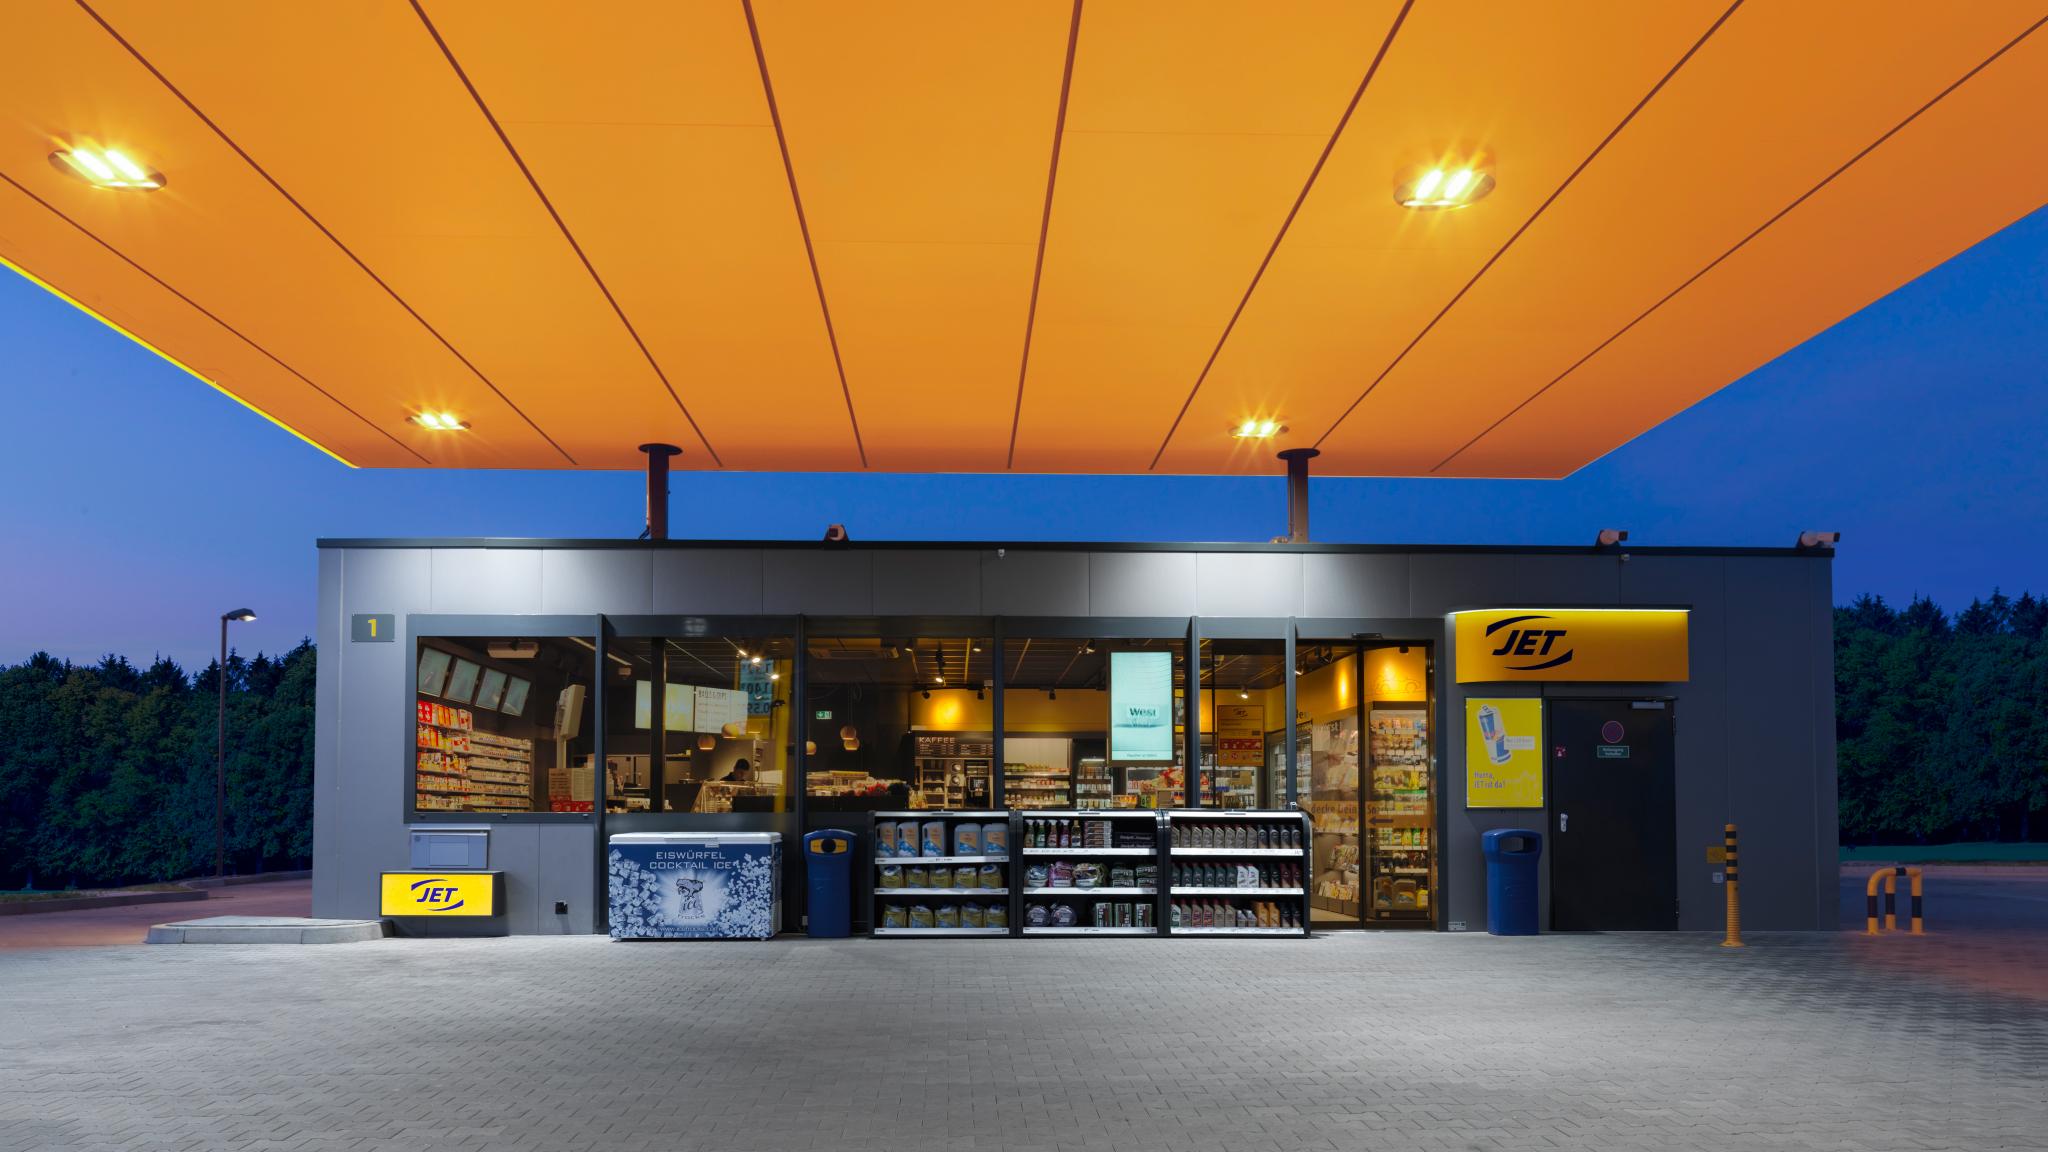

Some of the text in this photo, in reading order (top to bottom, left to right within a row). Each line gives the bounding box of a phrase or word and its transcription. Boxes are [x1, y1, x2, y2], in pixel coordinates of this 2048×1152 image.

[368, 618, 377, 637] 1
[1492, 630, 1567, 655] JET
[1129, 708, 1156, 716] West
[919, 736, 955, 744] KAFFEE
[656, 850, 726, 860] EISWÜRFEL
[649, 861, 732, 870] COCKTAIL ICE
[416, 888, 458, 902] JET
